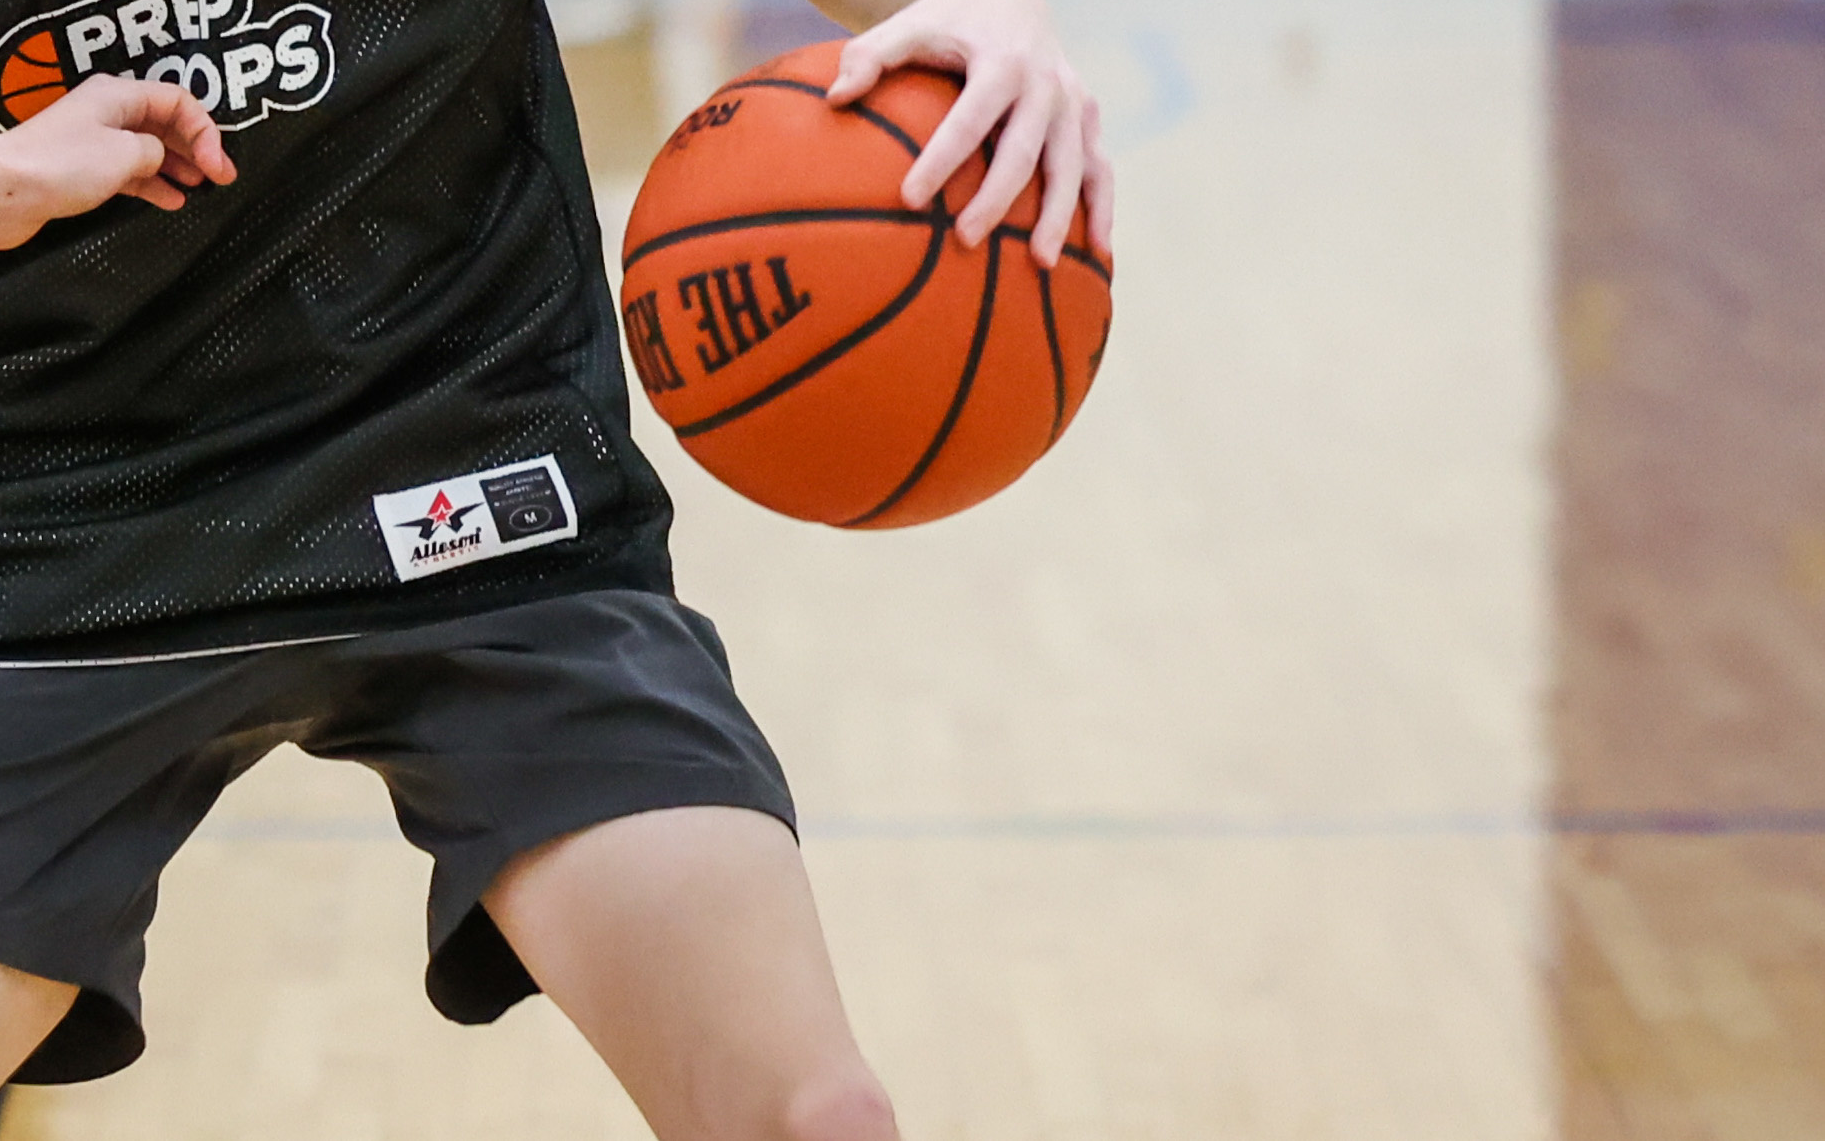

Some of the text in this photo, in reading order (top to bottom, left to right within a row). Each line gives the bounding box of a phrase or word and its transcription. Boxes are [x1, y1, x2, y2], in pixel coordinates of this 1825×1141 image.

[117, 24, 320, 113] OPS
[679, 257, 811, 375] THE
[524, 511, 538, 524] M
